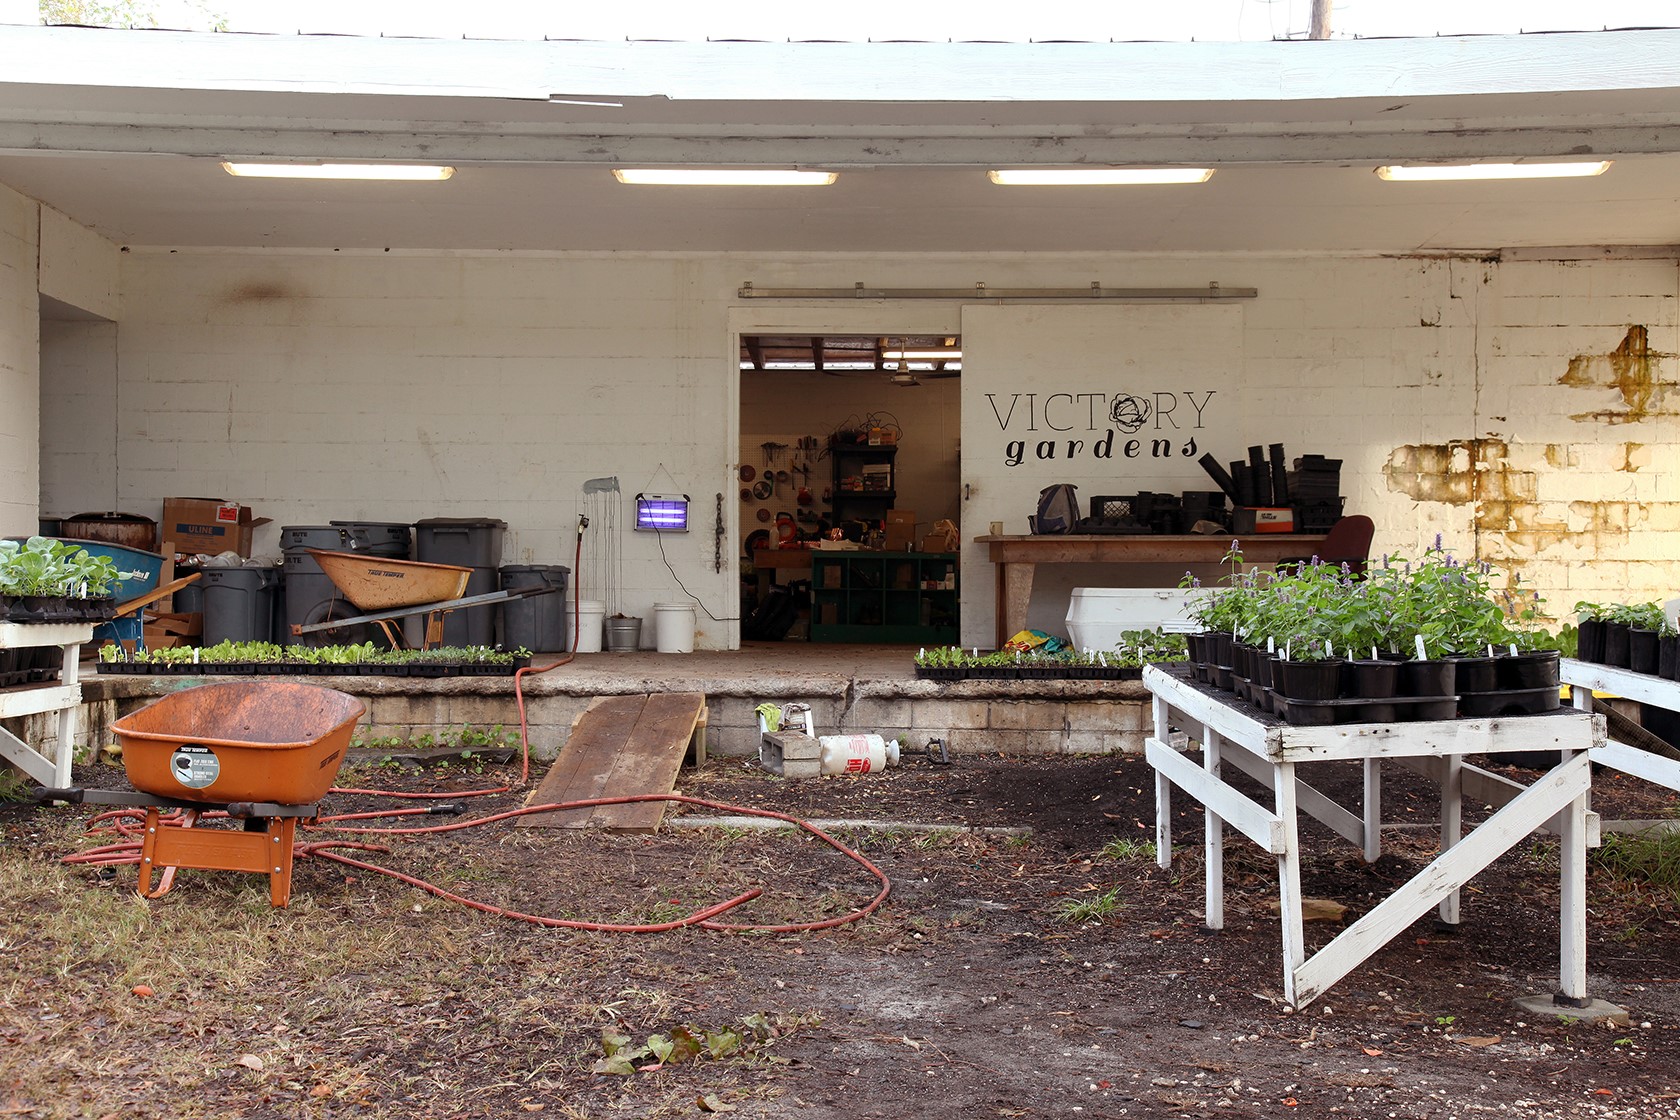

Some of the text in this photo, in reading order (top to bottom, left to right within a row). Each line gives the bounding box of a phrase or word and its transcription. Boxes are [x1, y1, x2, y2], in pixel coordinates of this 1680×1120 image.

[984, 391, 1217, 434] VICTORY
[1005, 428, 1198, 467] gardens
[188, 525, 214, 535] ULINE
